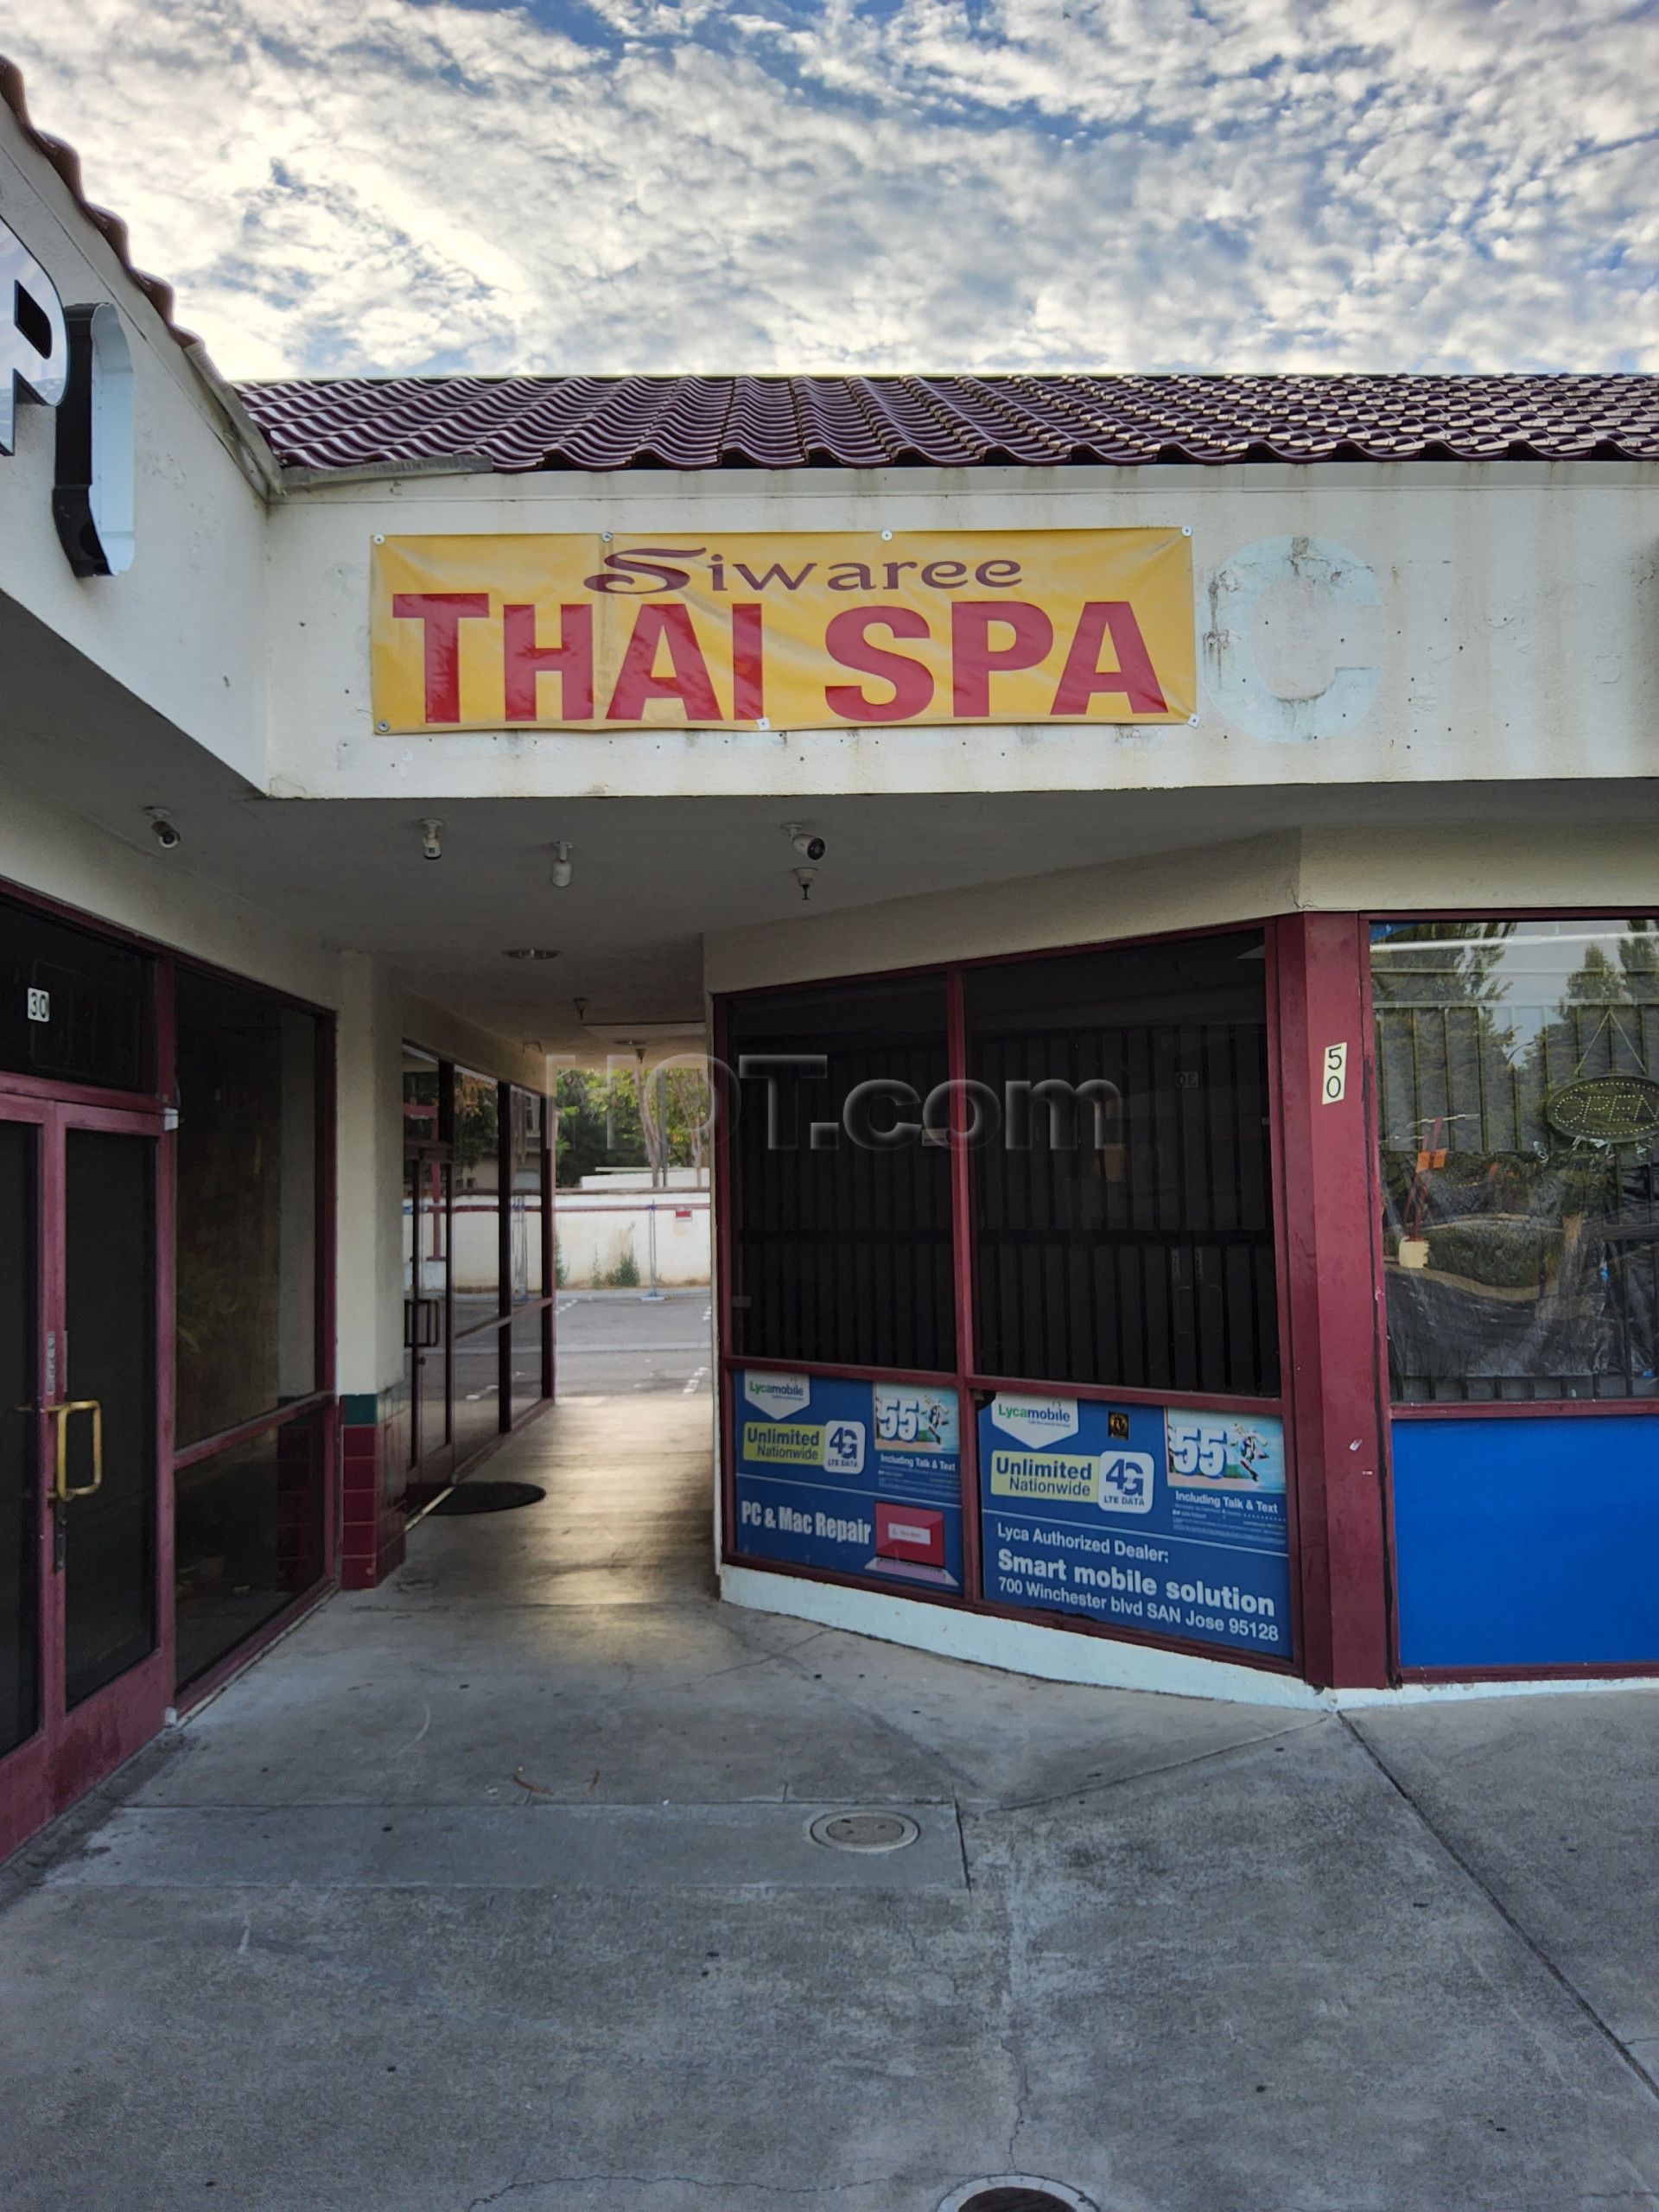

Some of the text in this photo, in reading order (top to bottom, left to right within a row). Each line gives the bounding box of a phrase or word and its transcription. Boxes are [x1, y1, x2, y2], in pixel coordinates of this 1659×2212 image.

[583, 547, 1023, 594] Siwaree
[393, 593, 1170, 724] THAI SPA
[30, 992, 48, 1019] 30
[1326, 1046, 1343, 1098] 50
[749, 1380, 804, 1395] Lycamobile
[998, 1402, 1071, 1422] Lycamobile
[747, 1427, 821, 1446] Unlimited
[830, 1427, 858, 1459] 4G
[757, 1445, 819, 1460] Nationwide
[880, 1453, 914, 1468] Including
[915, 1457, 931, 1468] Talk
[939, 1460, 956, 1471] Text
[996, 1457, 1092, 1481] Unlimited
[1105, 1459, 1144, 1497] 4G
[1009, 1476, 1091, 1497] Nationwide
[1103, 1495, 1146, 1507] LTE DATA
[1175, 1490, 1221, 1508] Including
[1223, 1496, 1243, 1510] Talk
[1245, 1499, 1255, 1511] &
[1255, 1500, 1279, 1515] Text
[741, 1500, 762, 1527] PC
[764, 1506, 777, 1529] &
[779, 1506, 813, 1535] Mac
[815, 1511, 872, 1545] Repair
[997, 1522, 1169, 1564] Lyca Authorized Dealer:
[998, 1548, 1275, 1618] Smart mobile solution
[998, 1576, 1280, 1642] 700 Winchester blvd SAN Jose 95128
